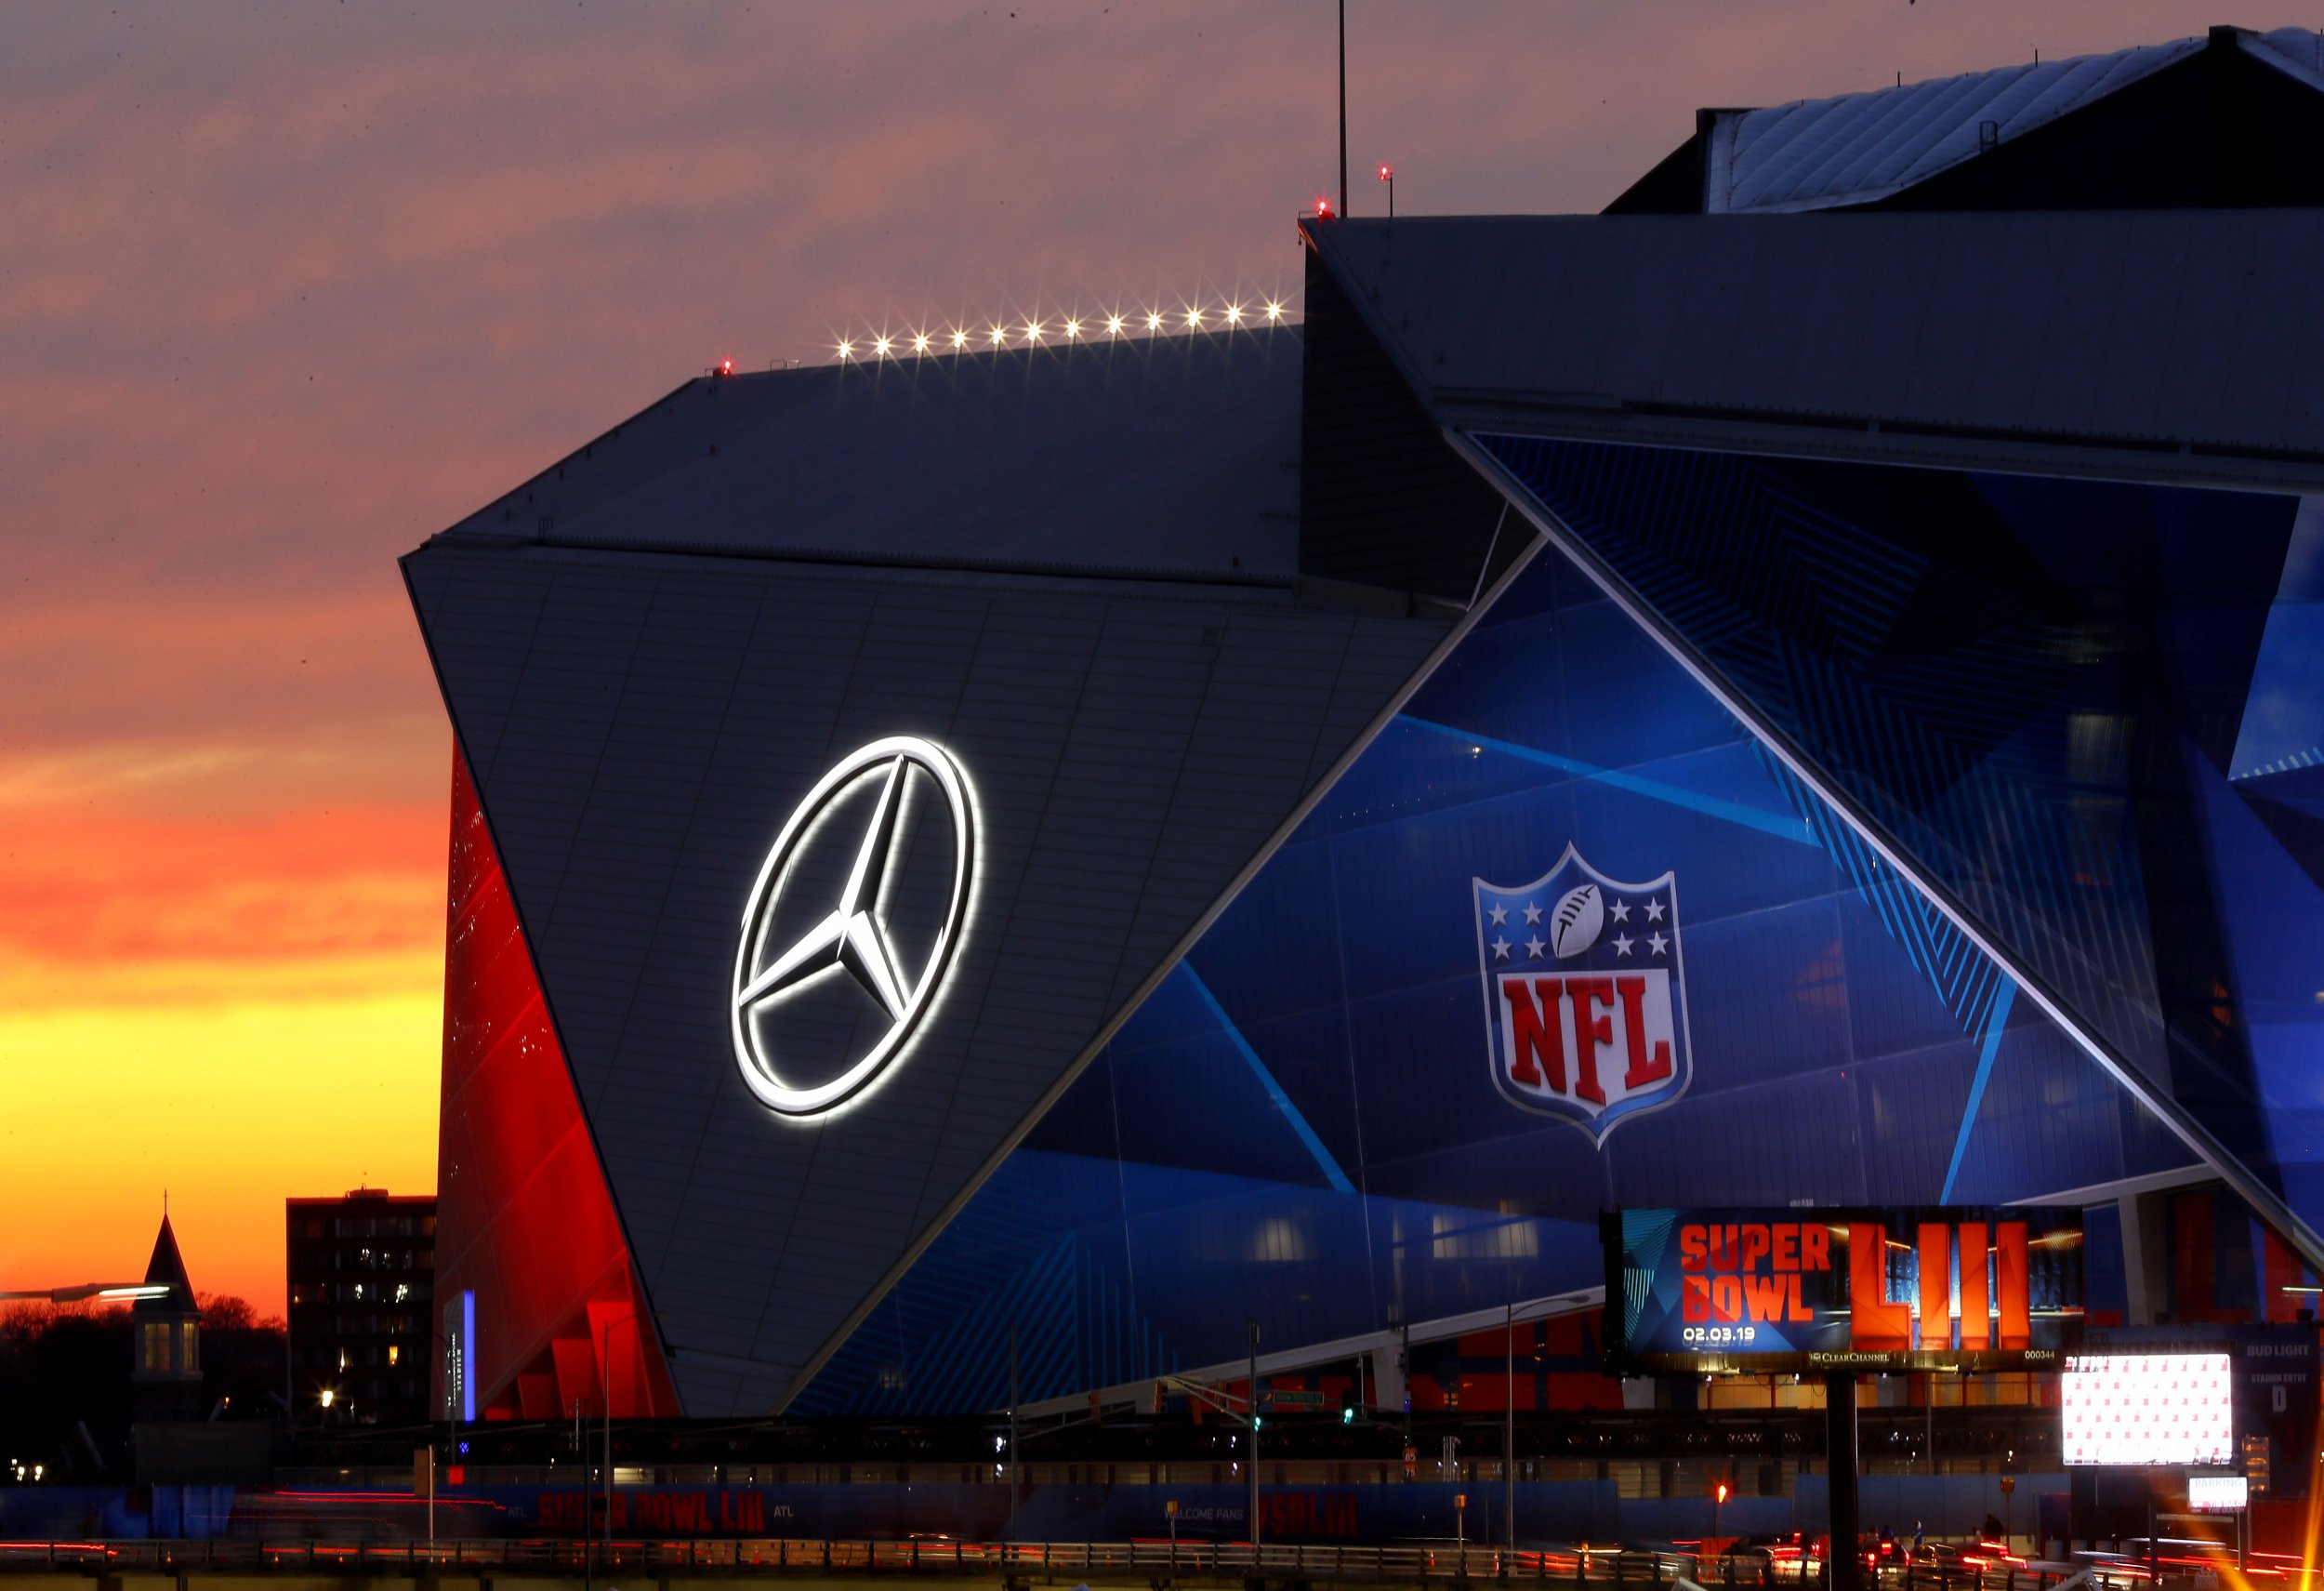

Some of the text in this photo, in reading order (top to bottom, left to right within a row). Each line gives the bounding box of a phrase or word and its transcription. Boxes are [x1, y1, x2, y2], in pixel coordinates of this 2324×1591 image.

[1502, 976, 1672, 1107] NFL
[1680, 1223, 1831, 1271] SUPER
[1848, 1222, 2031, 1346] LIII
[1682, 1275, 1814, 1322] BOWL
[1683, 1326, 1756, 1341] 02.03.19
[2025, 1350, 2055, 1359] 000344
[2246, 1344, 2310, 1357] BUD LIGHT
[2272, 1385, 2287, 1413] D
[2195, 1478, 2242, 1489] PARKING
[773, 1505, 794, 1518] ATL
[1216, 1507, 1244, 1520] FANS
